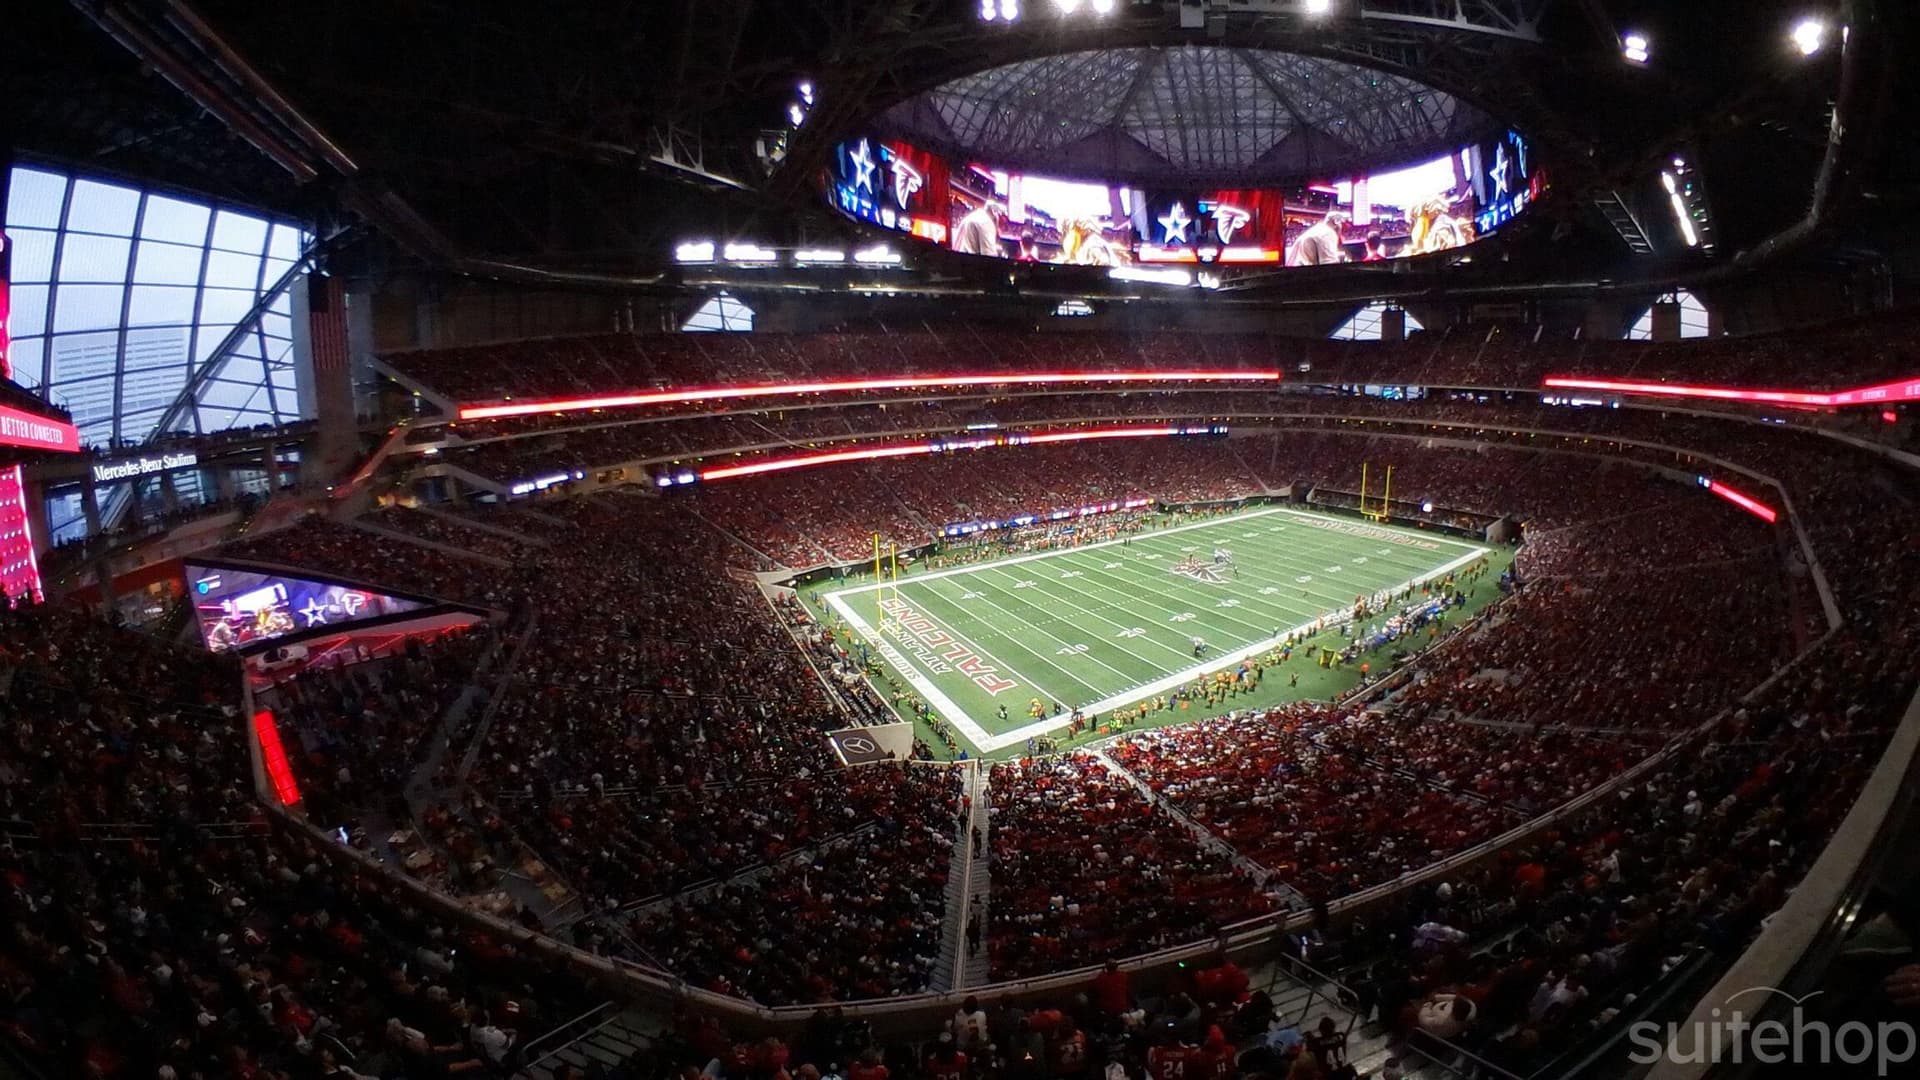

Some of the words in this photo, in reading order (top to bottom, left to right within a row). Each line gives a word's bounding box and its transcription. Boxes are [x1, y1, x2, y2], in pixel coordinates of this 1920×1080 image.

[1, 416, 29, 438] BETTER
[30, 422, 63, 444] CONNECTED
[94, 458, 162, 481] Mercedes-Benz
[164, 453, 197, 469] Stadium
[880, 598, 1018, 697] FALCONS
[1163, 1060, 1184, 1079] 24
